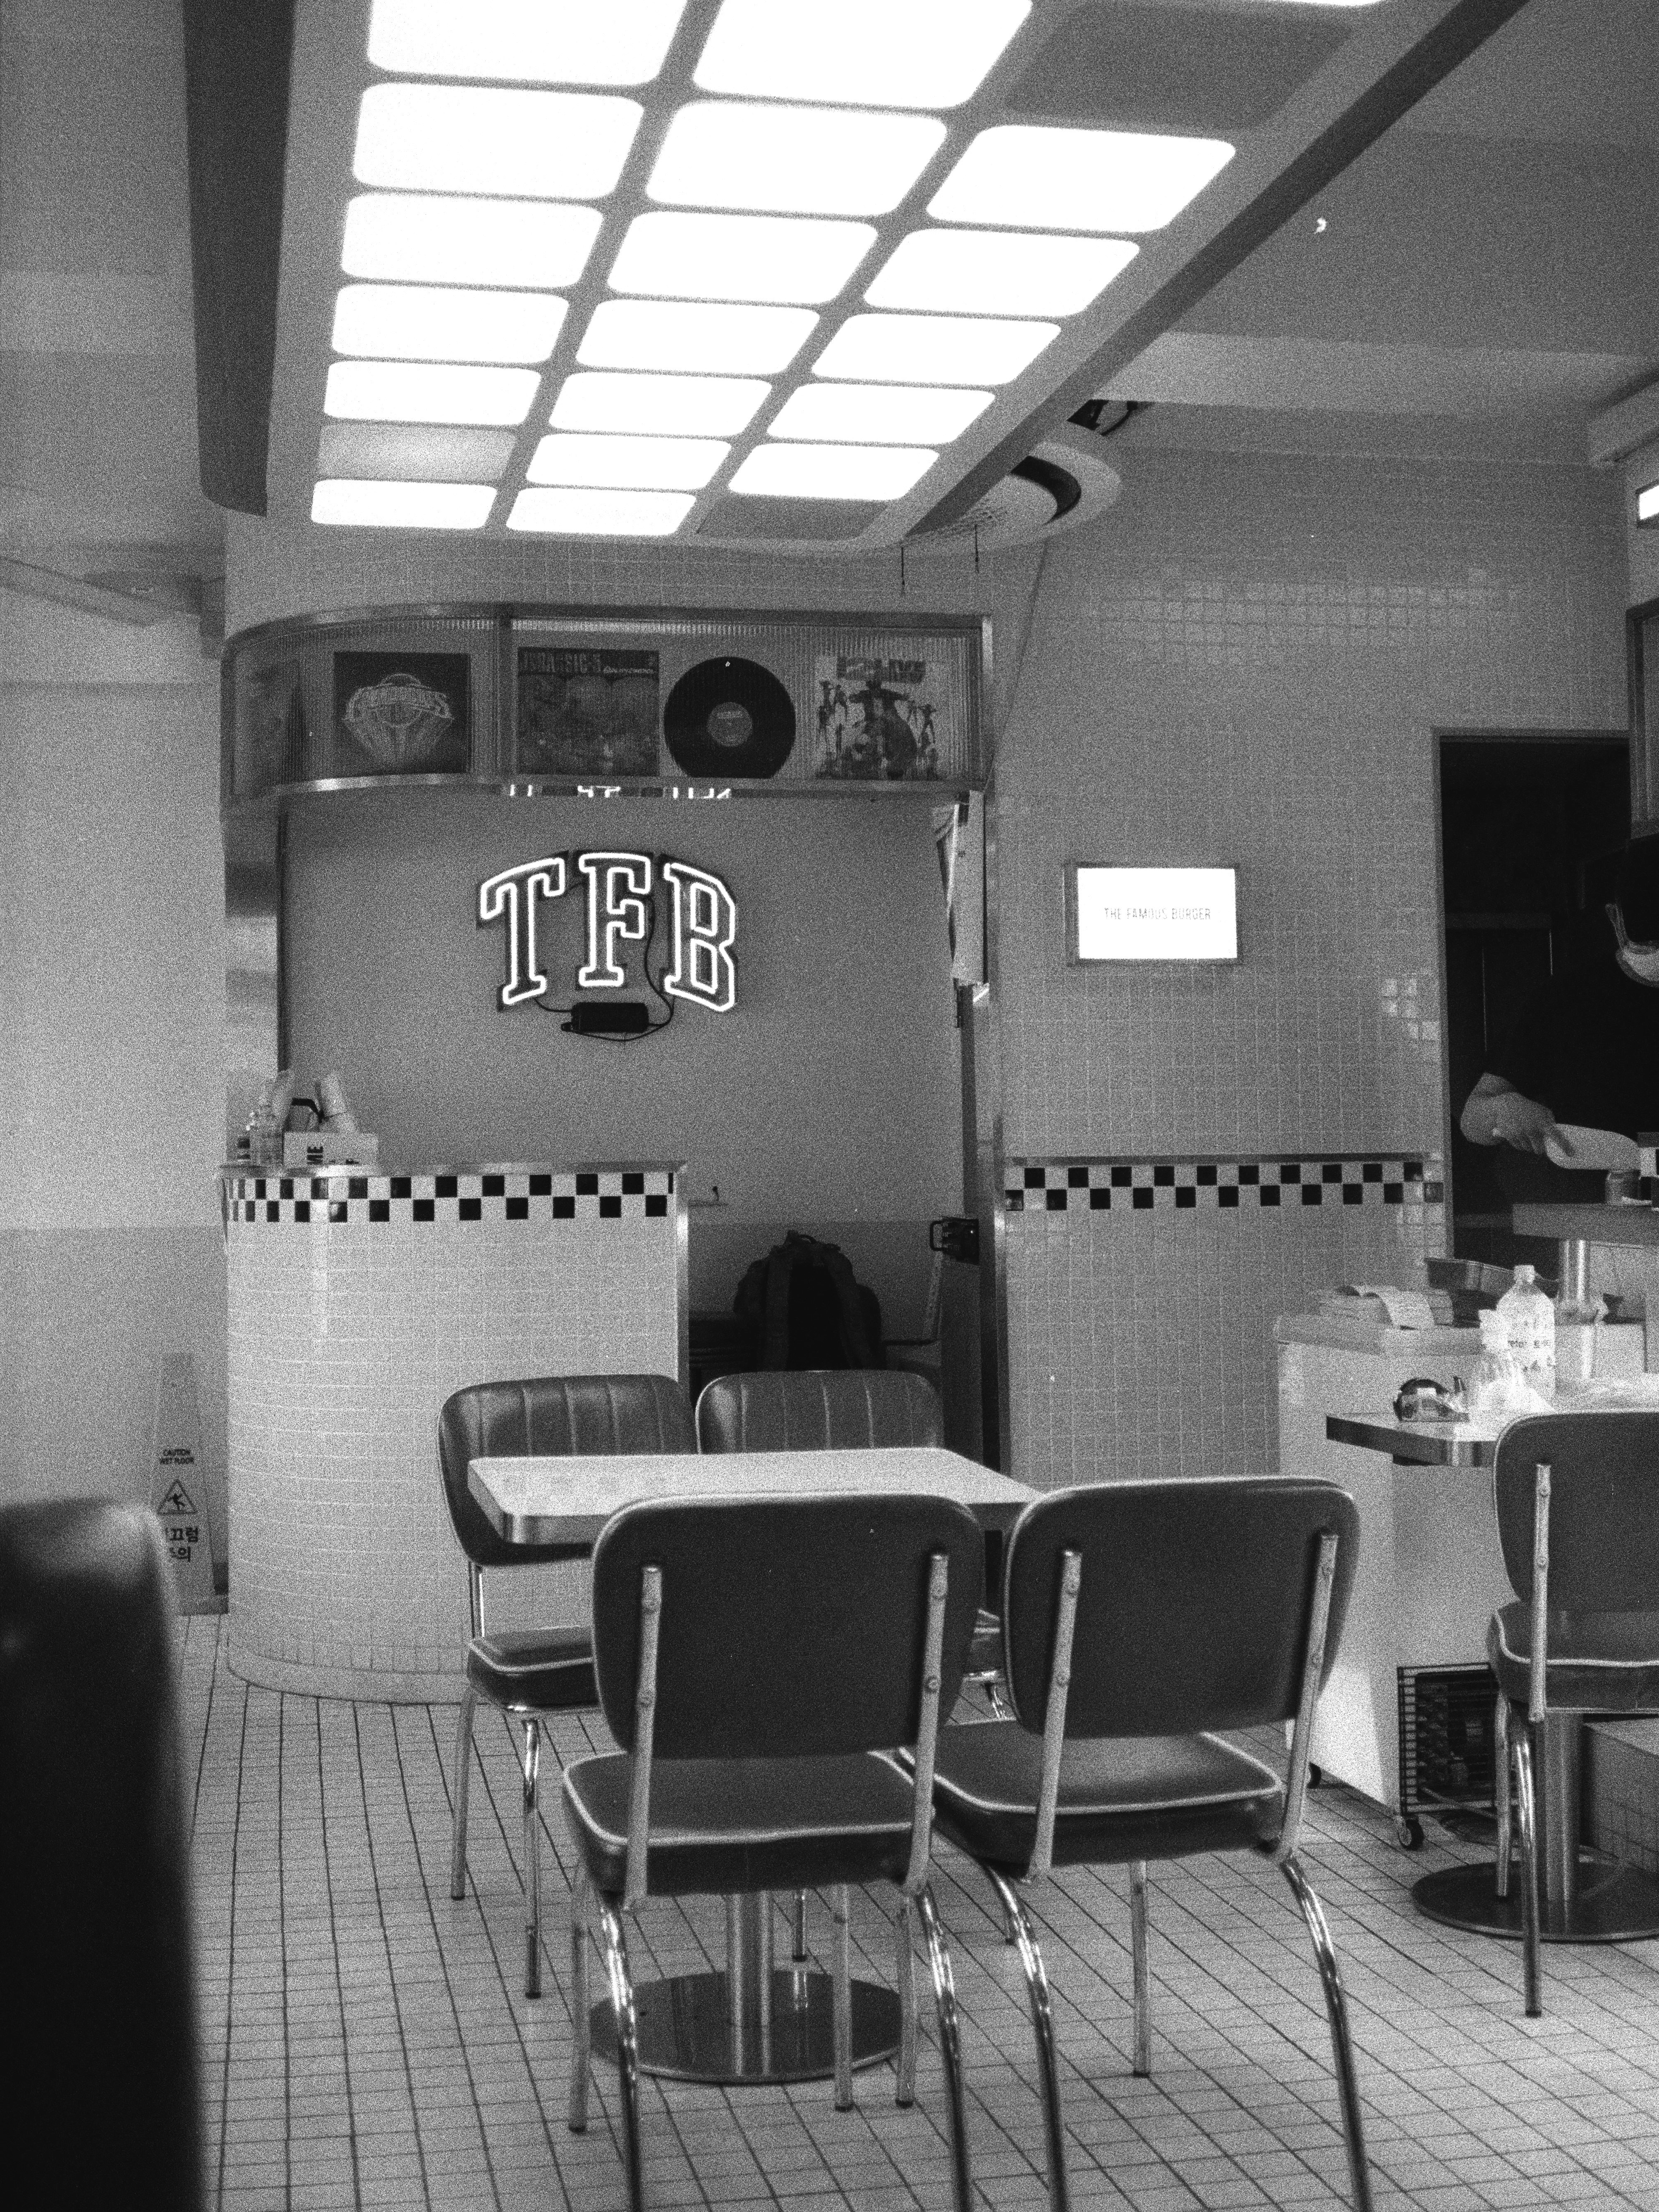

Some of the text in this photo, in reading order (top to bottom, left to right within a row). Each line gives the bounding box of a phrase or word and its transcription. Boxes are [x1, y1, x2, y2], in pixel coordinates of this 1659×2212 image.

[480, 852, 736, 1012] TFB
[1104, 908, 1210, 919] THE FAMOUS BURGER
